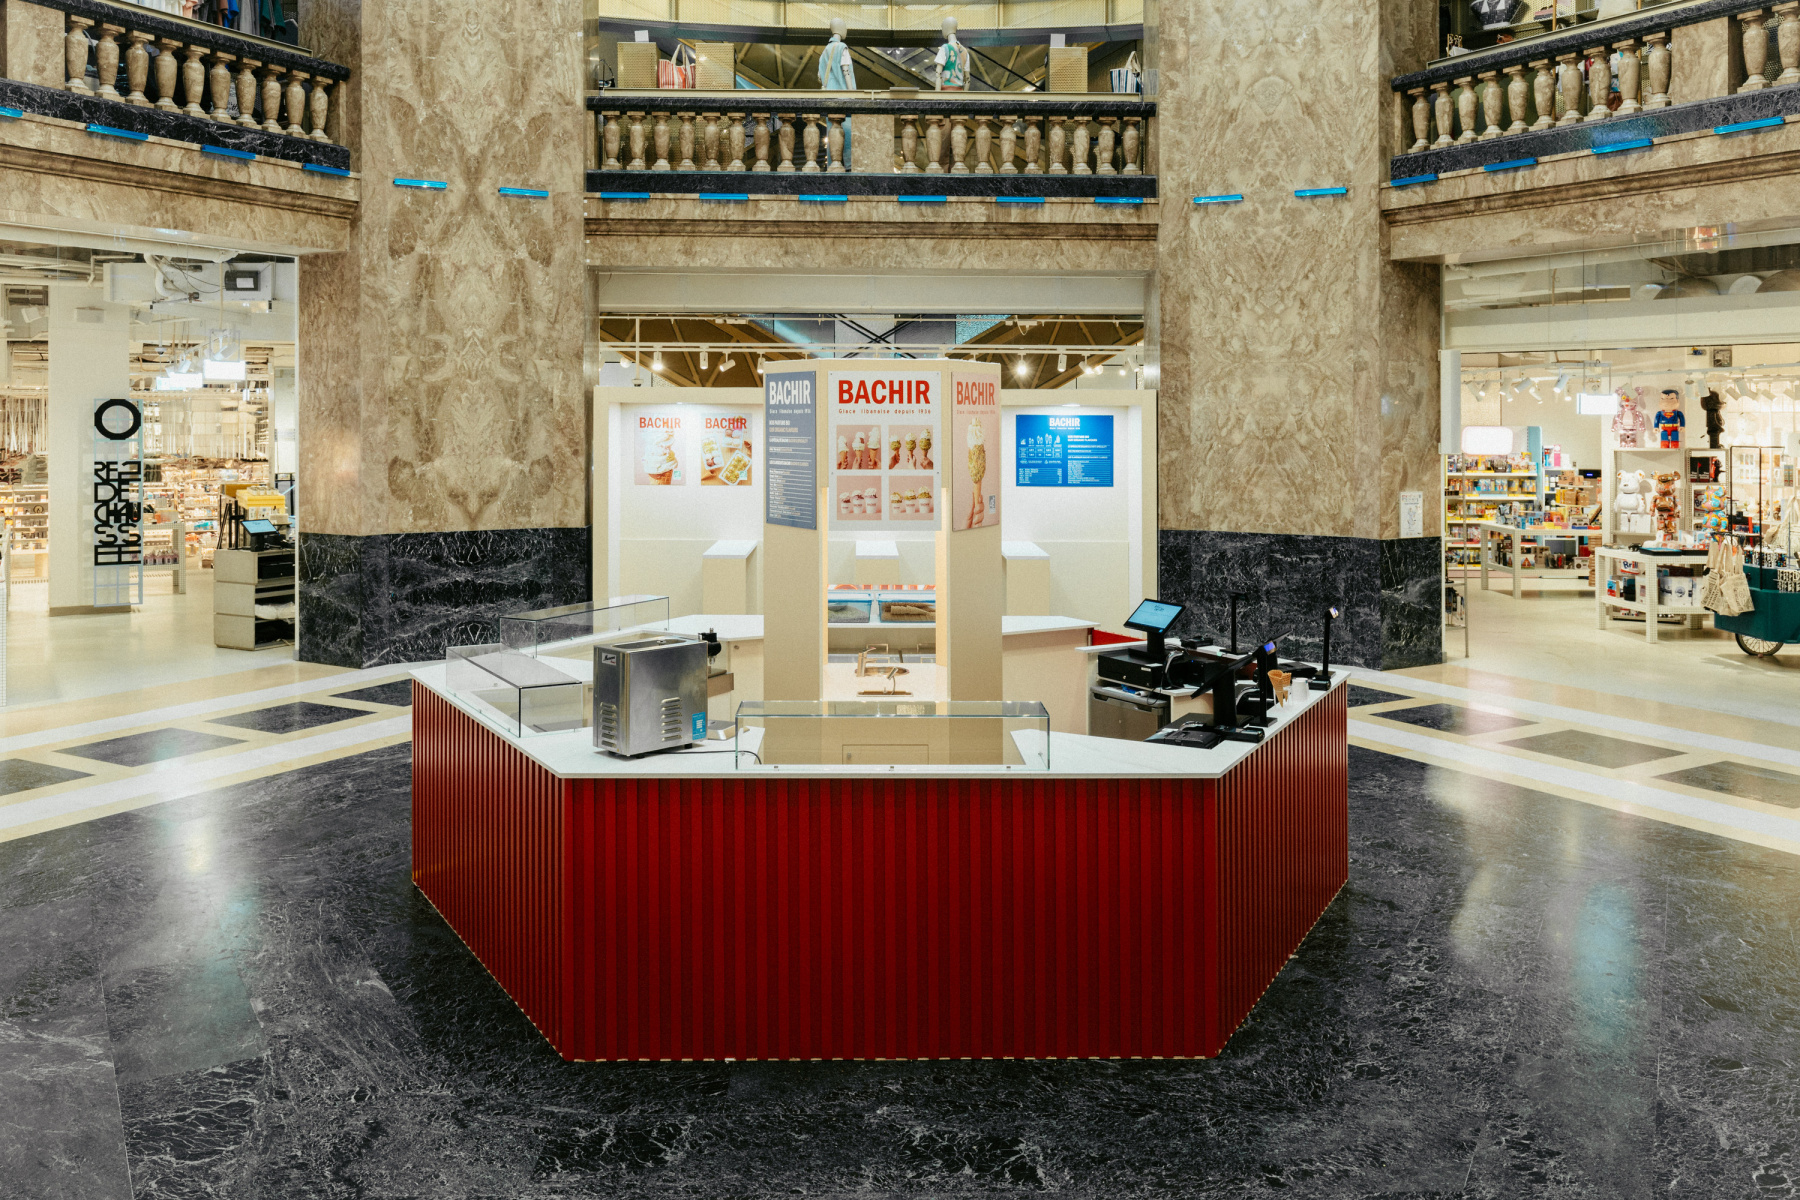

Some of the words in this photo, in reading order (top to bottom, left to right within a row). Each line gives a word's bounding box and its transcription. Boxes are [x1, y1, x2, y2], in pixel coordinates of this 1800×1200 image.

[769, 380, 811, 405] BACHIR
[838, 379, 930, 404] BACHIR
[956, 381, 995, 405] BACHIR
[639, 417, 681, 428] BACHIR
[705, 417, 747, 429] BACHIR
[1049, 417, 1080, 427] BACHIR
